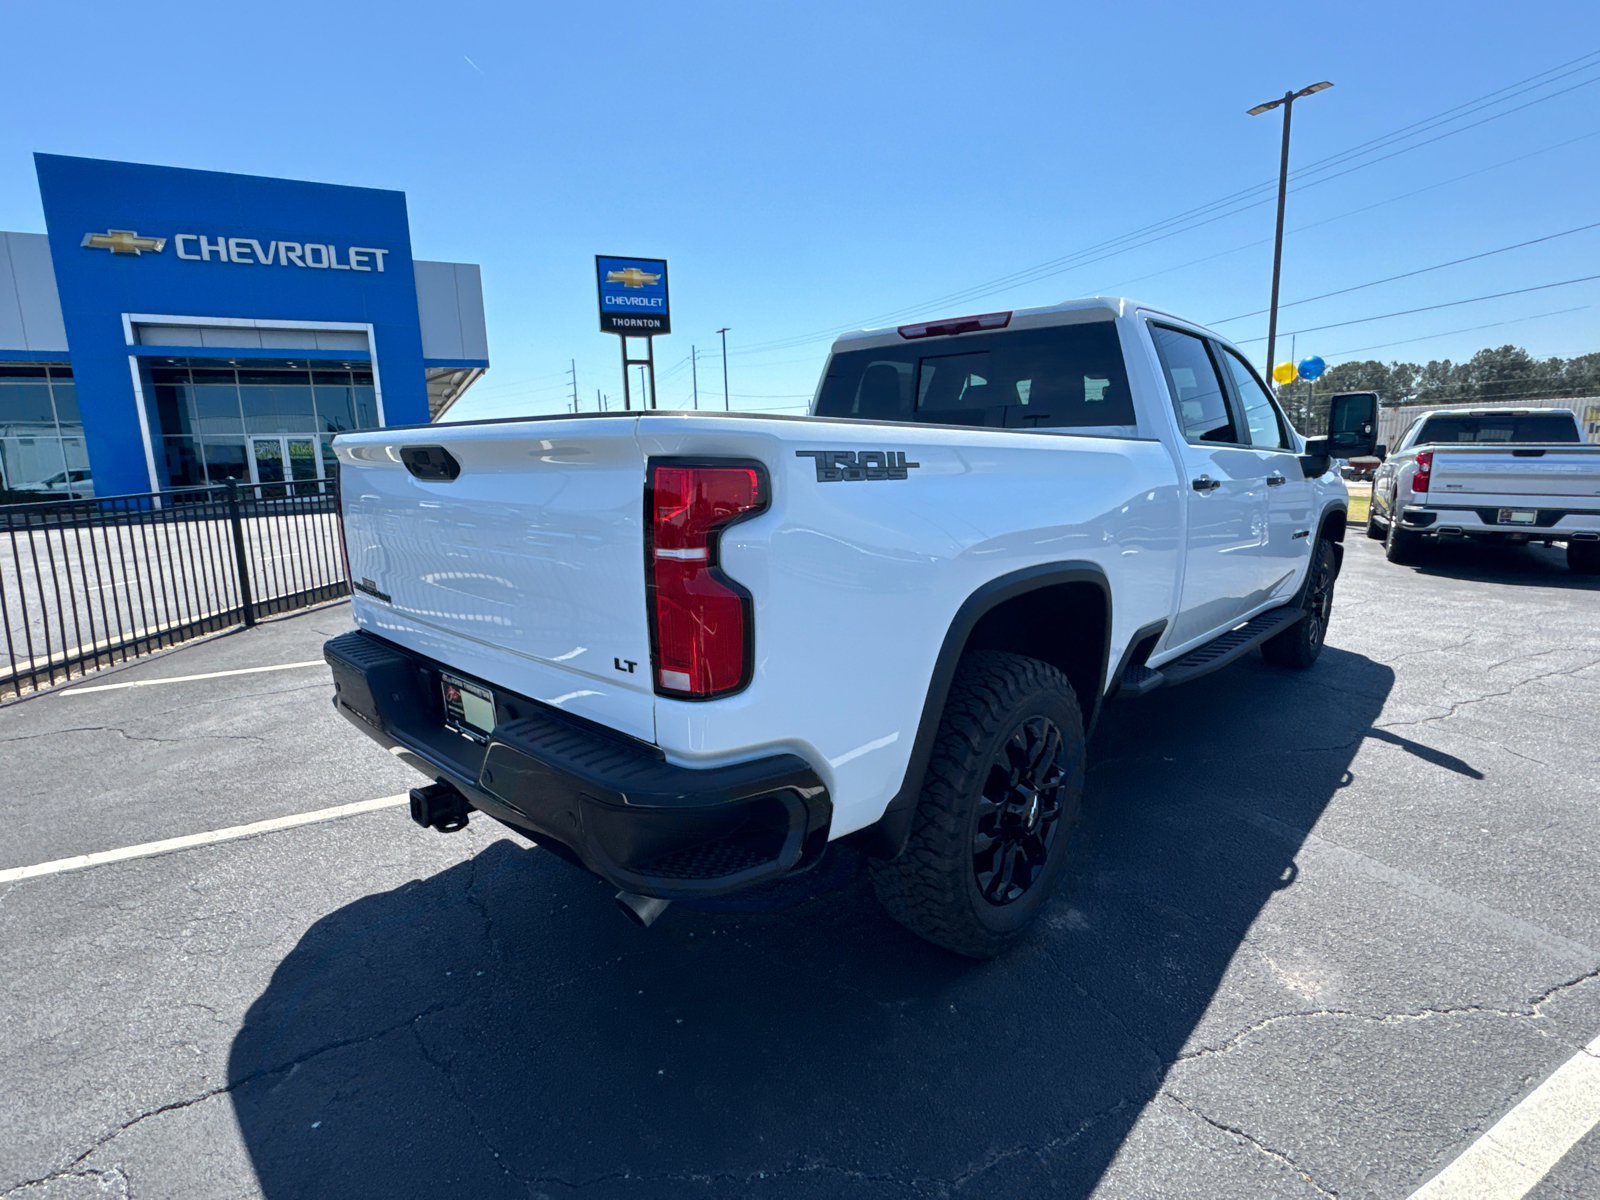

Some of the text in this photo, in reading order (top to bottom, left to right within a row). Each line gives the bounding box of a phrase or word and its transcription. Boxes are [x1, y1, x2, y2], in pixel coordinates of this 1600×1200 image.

[175, 233, 389, 272] CHEVROLET
[605, 295, 663, 307] CHEVROLET
[612, 317, 660, 328] THORNTON
[795, 450, 920, 468] TRAIL
[816, 467, 908, 482] BOSS
[614, 657, 638, 674] LT
